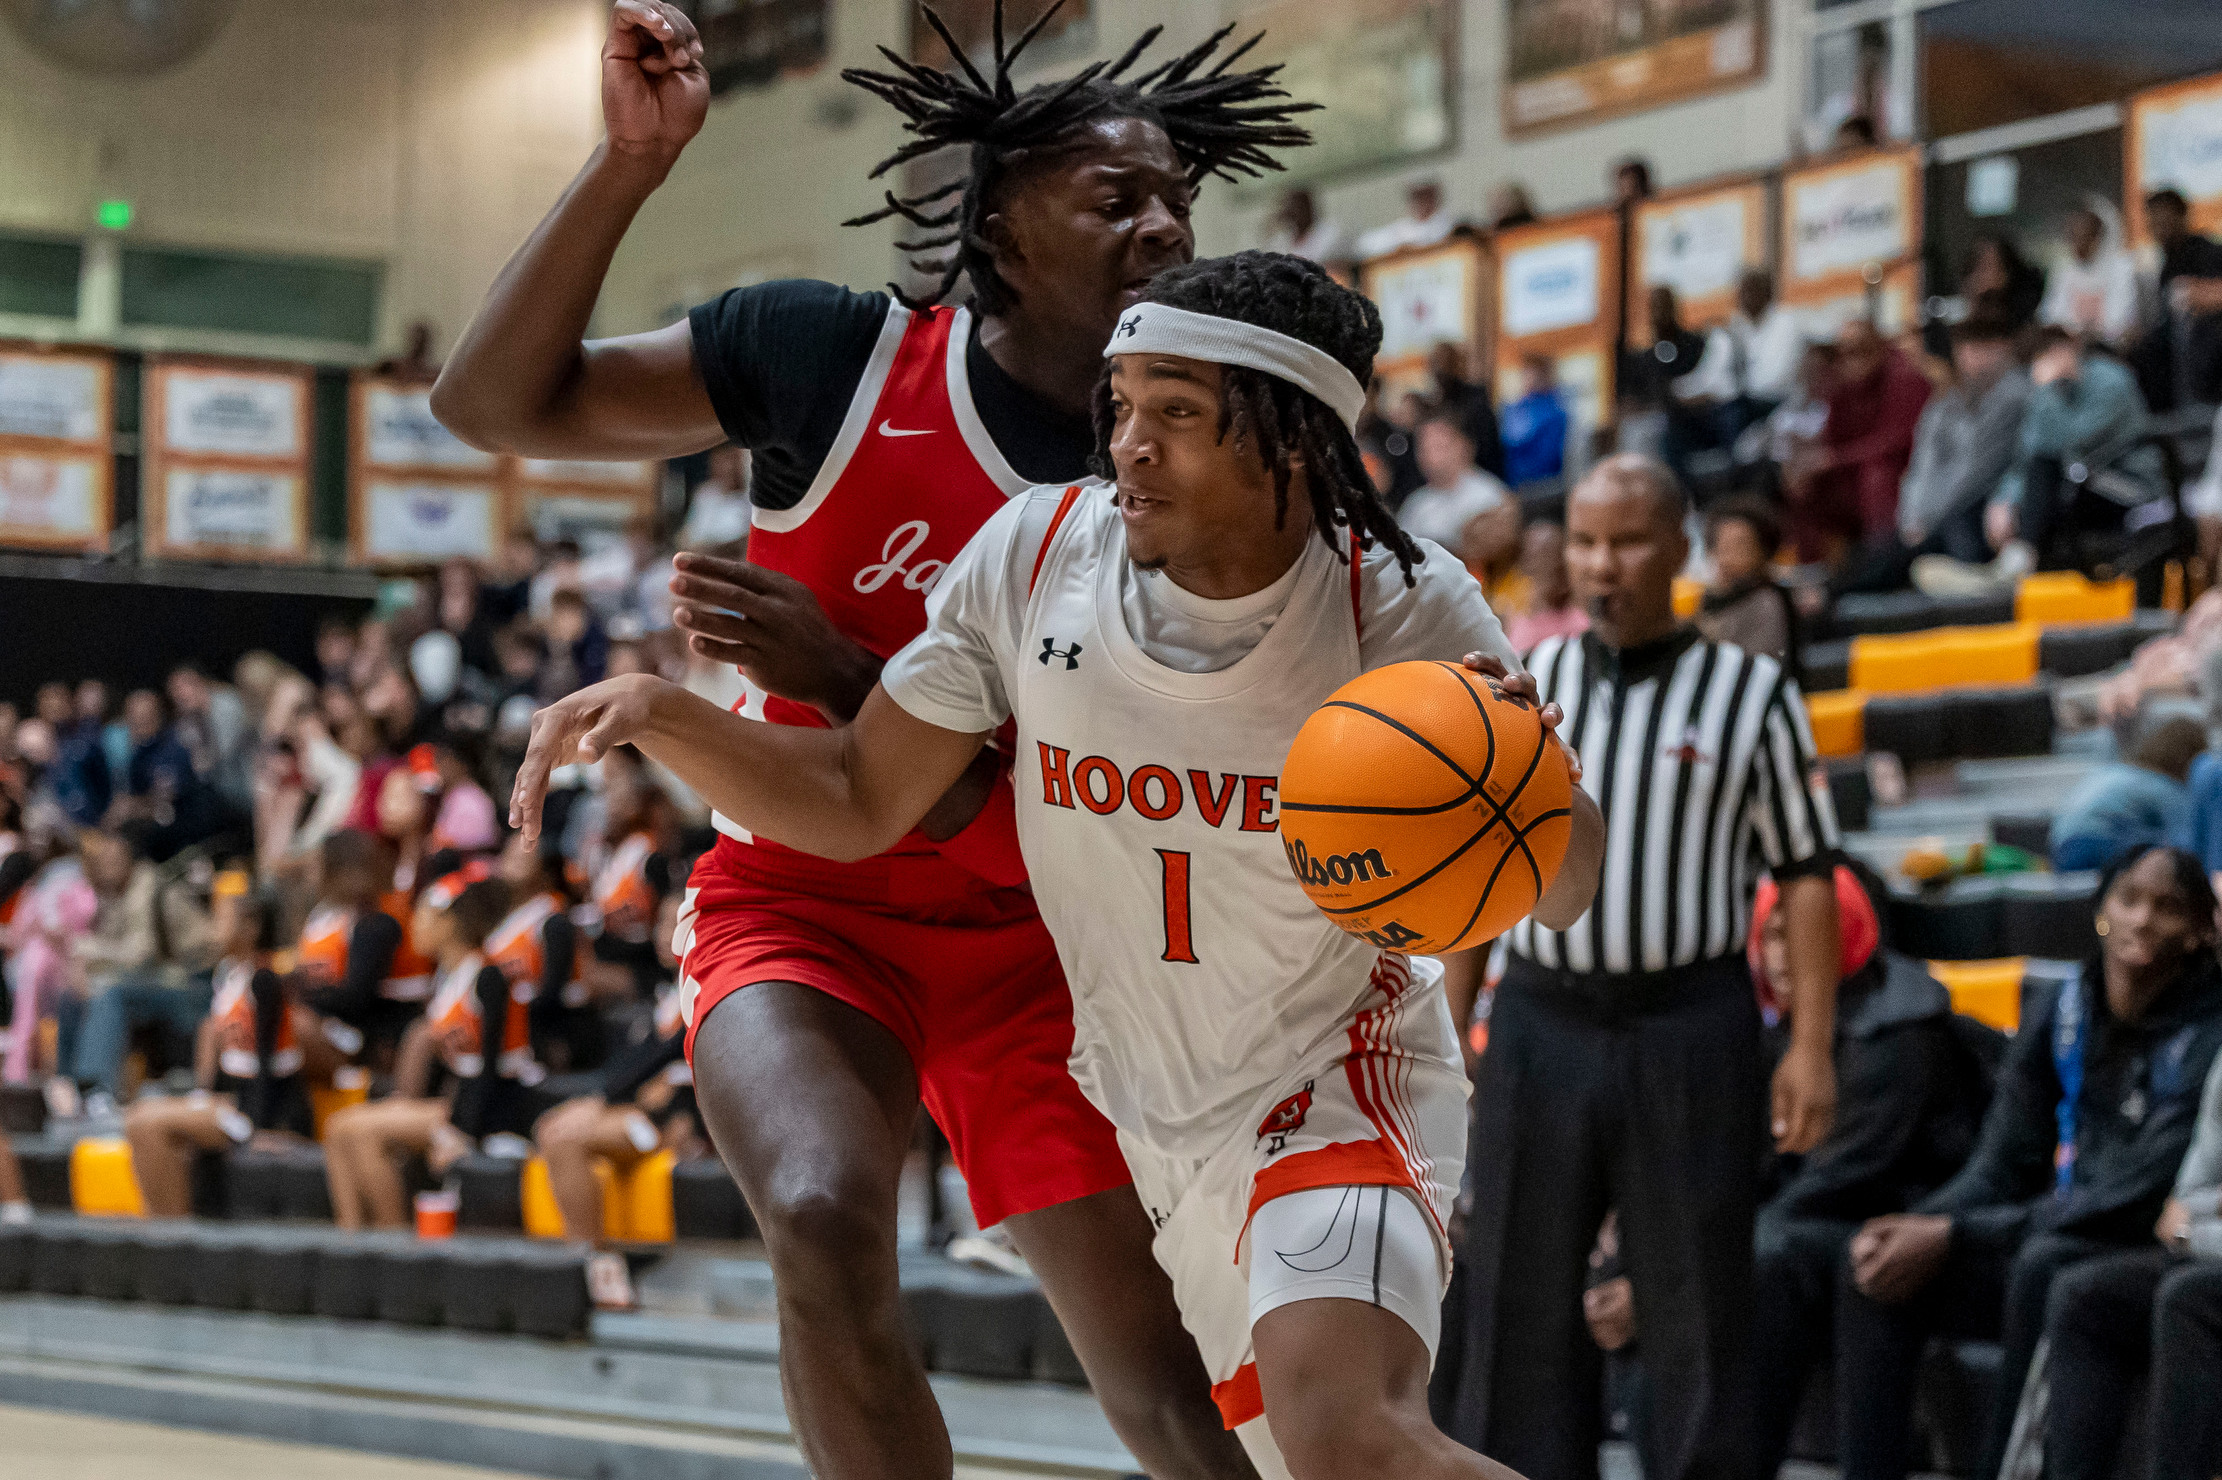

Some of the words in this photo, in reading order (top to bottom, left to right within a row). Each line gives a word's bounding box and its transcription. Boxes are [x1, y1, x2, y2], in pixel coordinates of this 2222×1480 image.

[853, 519, 950, 596] Ja
[1036, 739, 1280, 833] HOOVE
[1281, 833, 1393, 887] ilson
[1152, 847, 1200, 965] 1
[1347, 921, 1426, 949] AA
